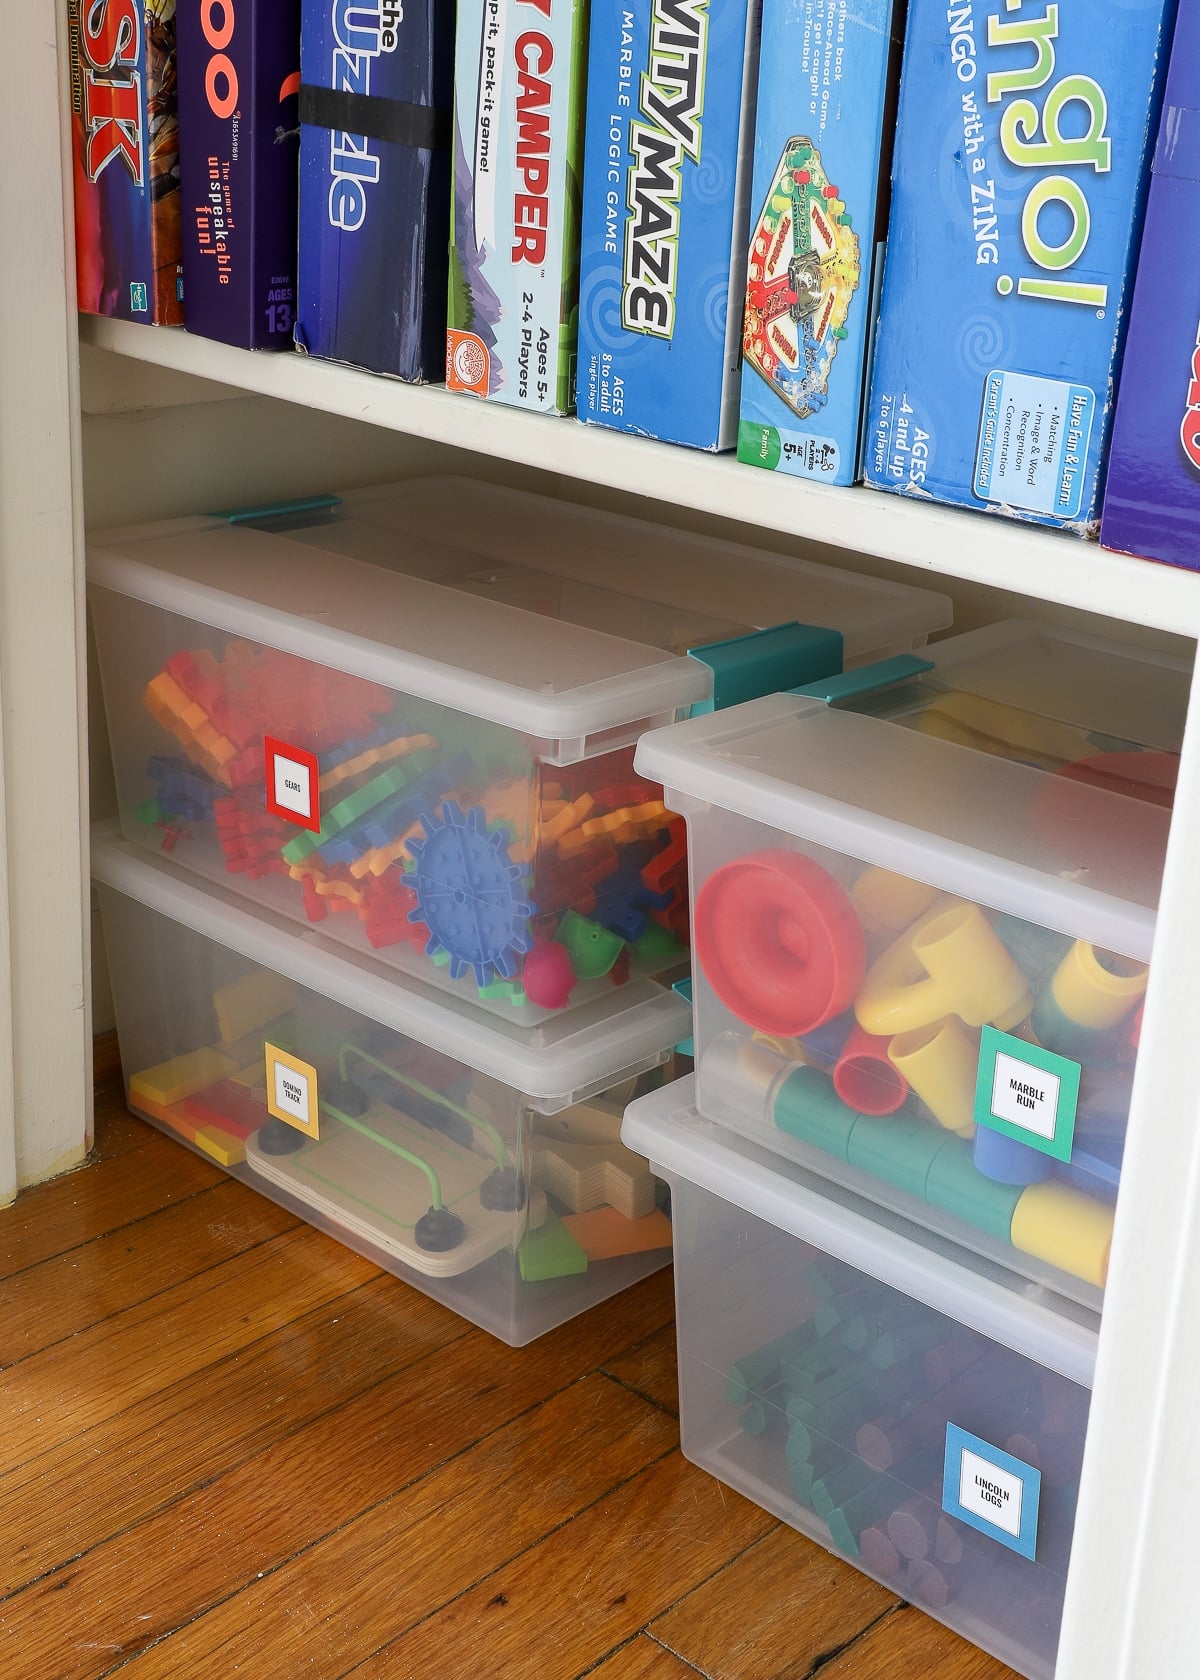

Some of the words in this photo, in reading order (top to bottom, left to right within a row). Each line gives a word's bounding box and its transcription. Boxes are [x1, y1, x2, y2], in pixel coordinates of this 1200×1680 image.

[814, 23, 822, 45] get
[70, 25, 82, 113] Domination
[618, 11, 635, 107] MARBLE
[810, 50, 820, 97] caught
[834, 48, 844, 81] back
[484, 46, 497, 111] pack-it
[810, 101, 817, 114] or
[962, 91, 985, 154] with
[480, 117, 491, 172] game!
[511, 29, 554, 266] CAMPER
[608, 115, 622, 183] LOGIC
[987, 0, 1112, 307] ngo!
[222, 161, 230, 180] The
[972, 158, 986, 174] a
[222, 185, 231, 213] game
[195, 206, 216, 254] fun!
[208, 156, 232, 284] unspeakable
[227, 218, 235, 228] of
[605, 191, 618, 253] GAME
[971, 179, 999, 265] ZING
[268, 289, 293, 302] AGES
[522, 292, 533, 322] 2-4
[518, 329, 532, 398] Players
[536, 327, 550, 375] Ages
[602, 353, 612, 362] 8
[588, 355, 598, 381] single
[602, 364, 611, 377] to
[537, 381, 548, 402] 5+
[588, 383, 598, 410] player
[601, 380, 612, 413] adult
[612, 376, 625, 416] AGES
[882, 394, 892, 403] 2
[881, 405, 890, 417] to
[1070, 395, 1088, 428] Have
[896, 418, 911, 451] and
[983, 419, 997, 446] Guide
[998, 405, 1016, 477] Concentration
[1015, 410, 1031, 471] Recognition
[1030, 411, 1045, 444] Image
[1043, 414, 1060, 464] Matching
[1066, 428, 1083, 452] Fun
[759, 429, 770, 460] Family
[784, 443, 797, 461] 5+
[808, 440, 816, 471] PLAYERS
[874, 430, 888, 473] players
[909, 427, 930, 483] AGES
[1031, 445, 1041, 455] &
[889, 455, 905, 477] up
[978, 448, 993, 489] Included
[1026, 458, 1039, 486] Word
[1064, 455, 1080, 466] &
[285, 779, 301, 793] GEARS
[282, 1080, 302, 1097] DOMINO
[285, 1089, 301, 1105] TRACK
[1009, 1078, 1046, 1102] MARBLE
[1016, 1093, 1036, 1110] RUN
[974, 1475, 1010, 1501] LINCOLN
[980, 1489, 1002, 1509] LOGS
